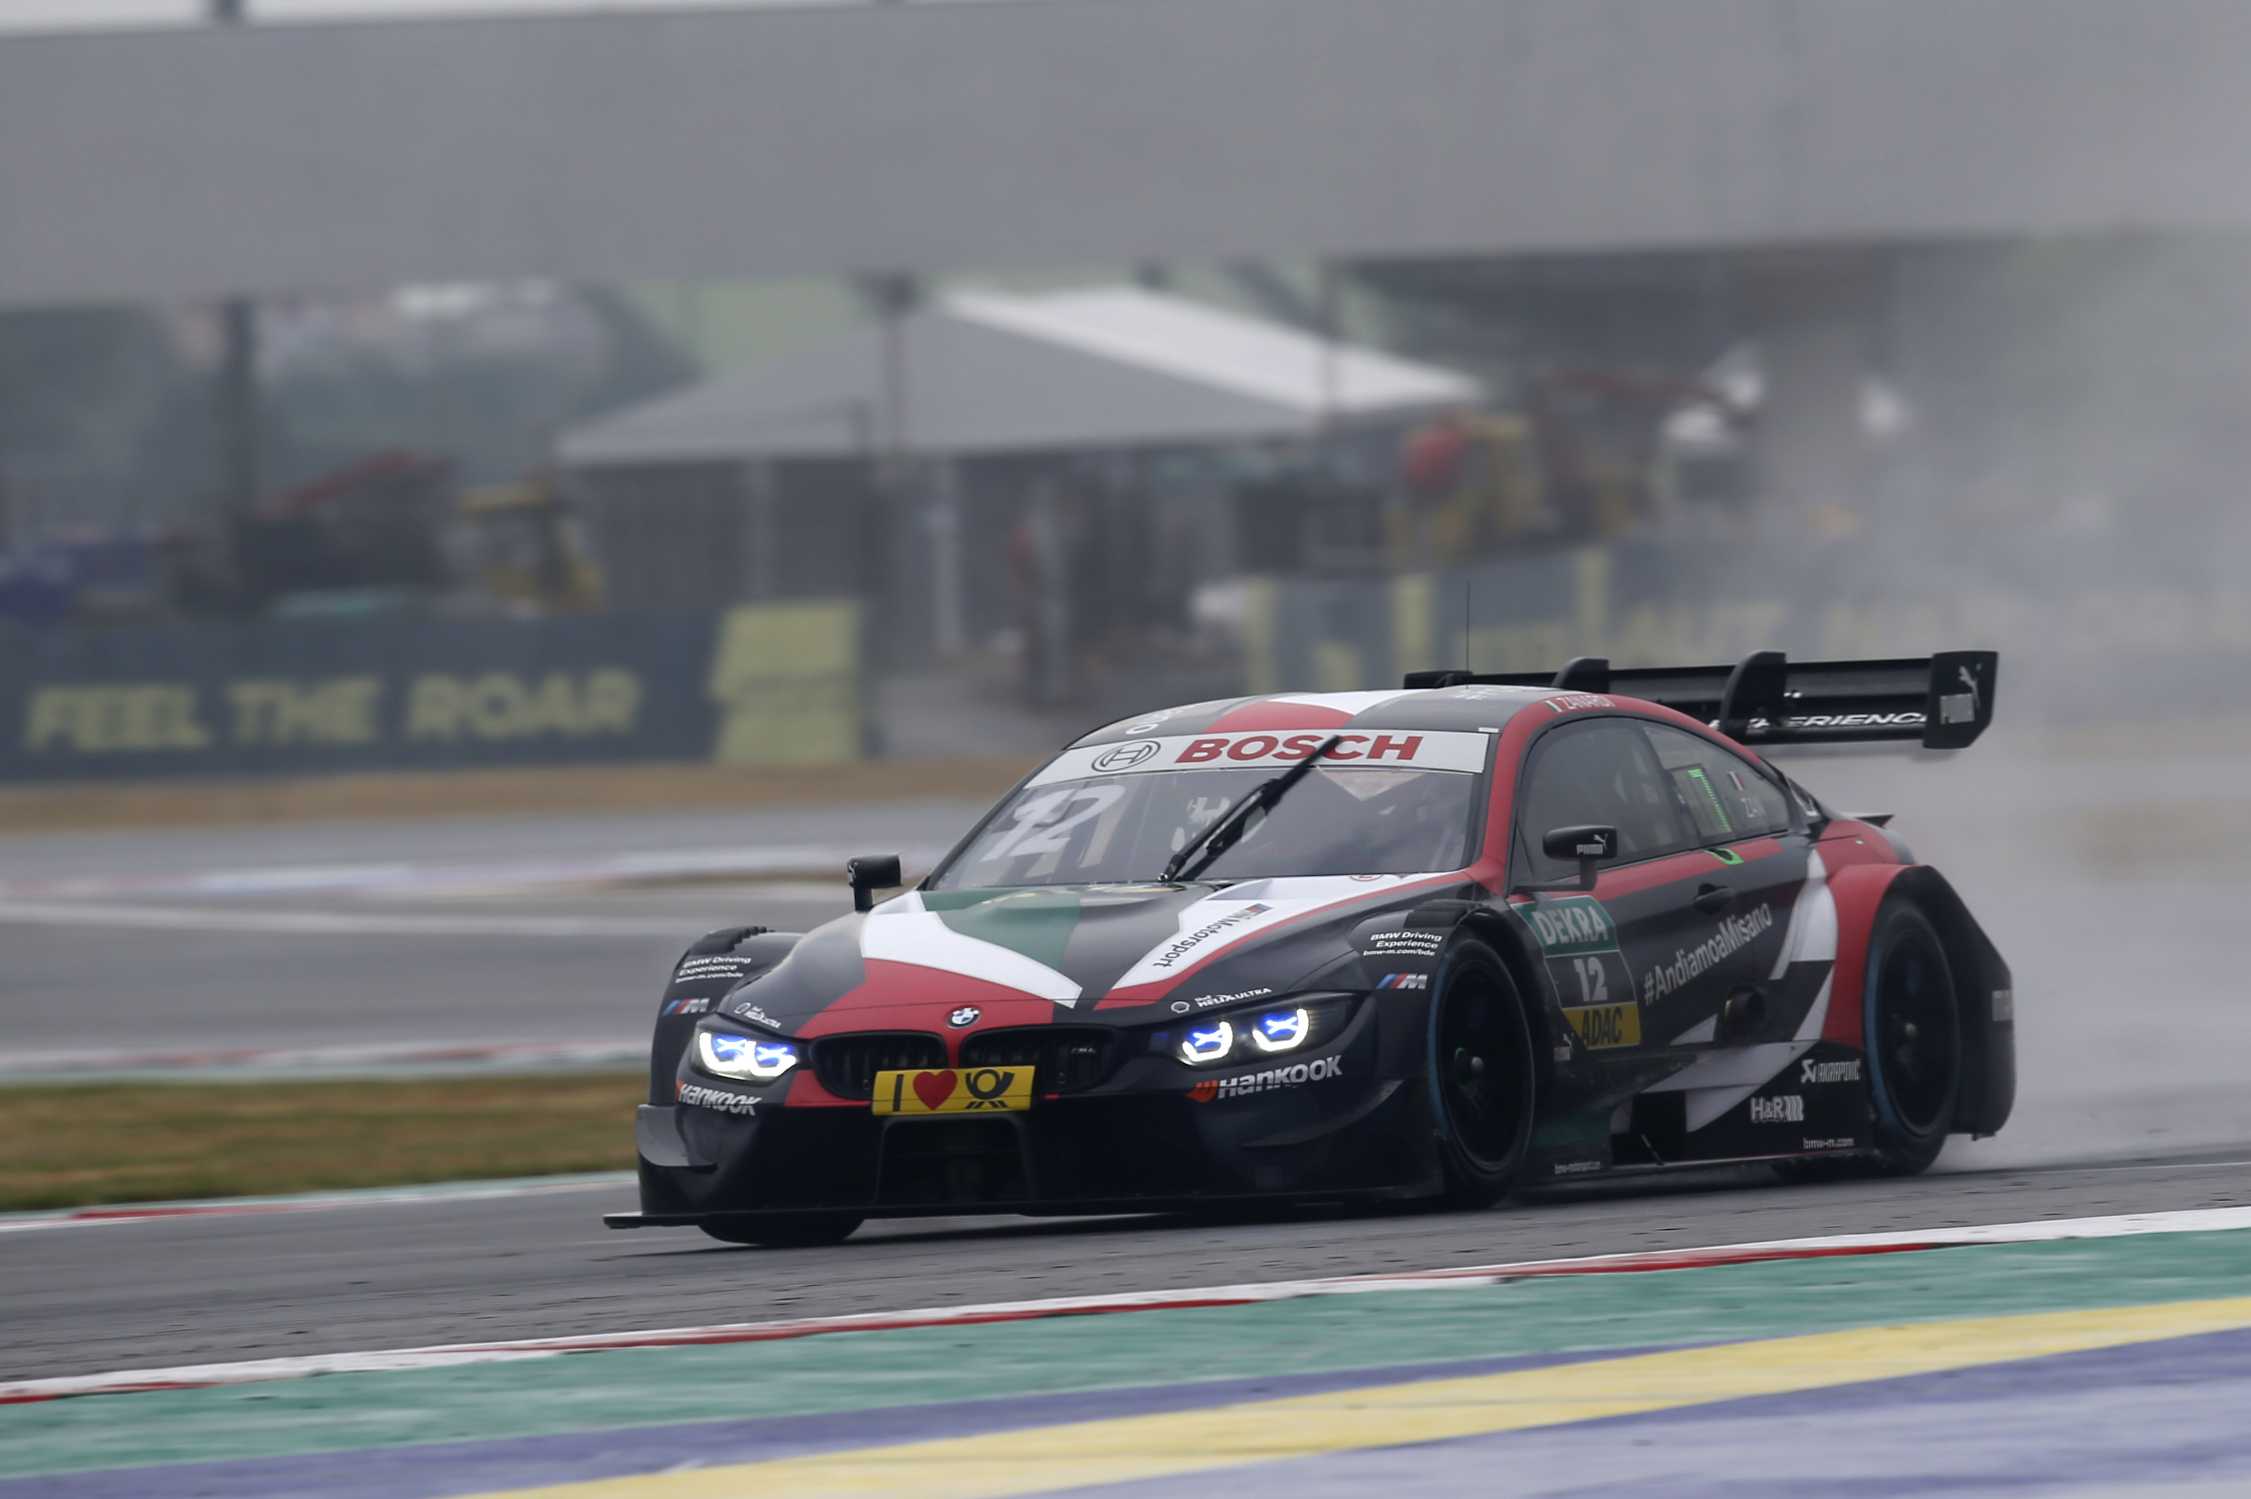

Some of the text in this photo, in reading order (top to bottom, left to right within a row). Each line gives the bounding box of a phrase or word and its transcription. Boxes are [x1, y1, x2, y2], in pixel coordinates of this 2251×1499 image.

[24, 667, 641, 752] FEEL THE ROAR
[1174, 734, 1424, 764] BOSCH
[1370, 930, 1443, 942] BMW Driving
[1375, 940, 1439, 950] Experience
[1530, 905, 1609, 946] DEKRA
[1643, 902, 1773, 1007] #AndiamoaMisano
[1573, 956, 1608, 1001] 12
[1582, 1006, 1624, 1047] ADAC
[892, 1074, 904, 1113] I
